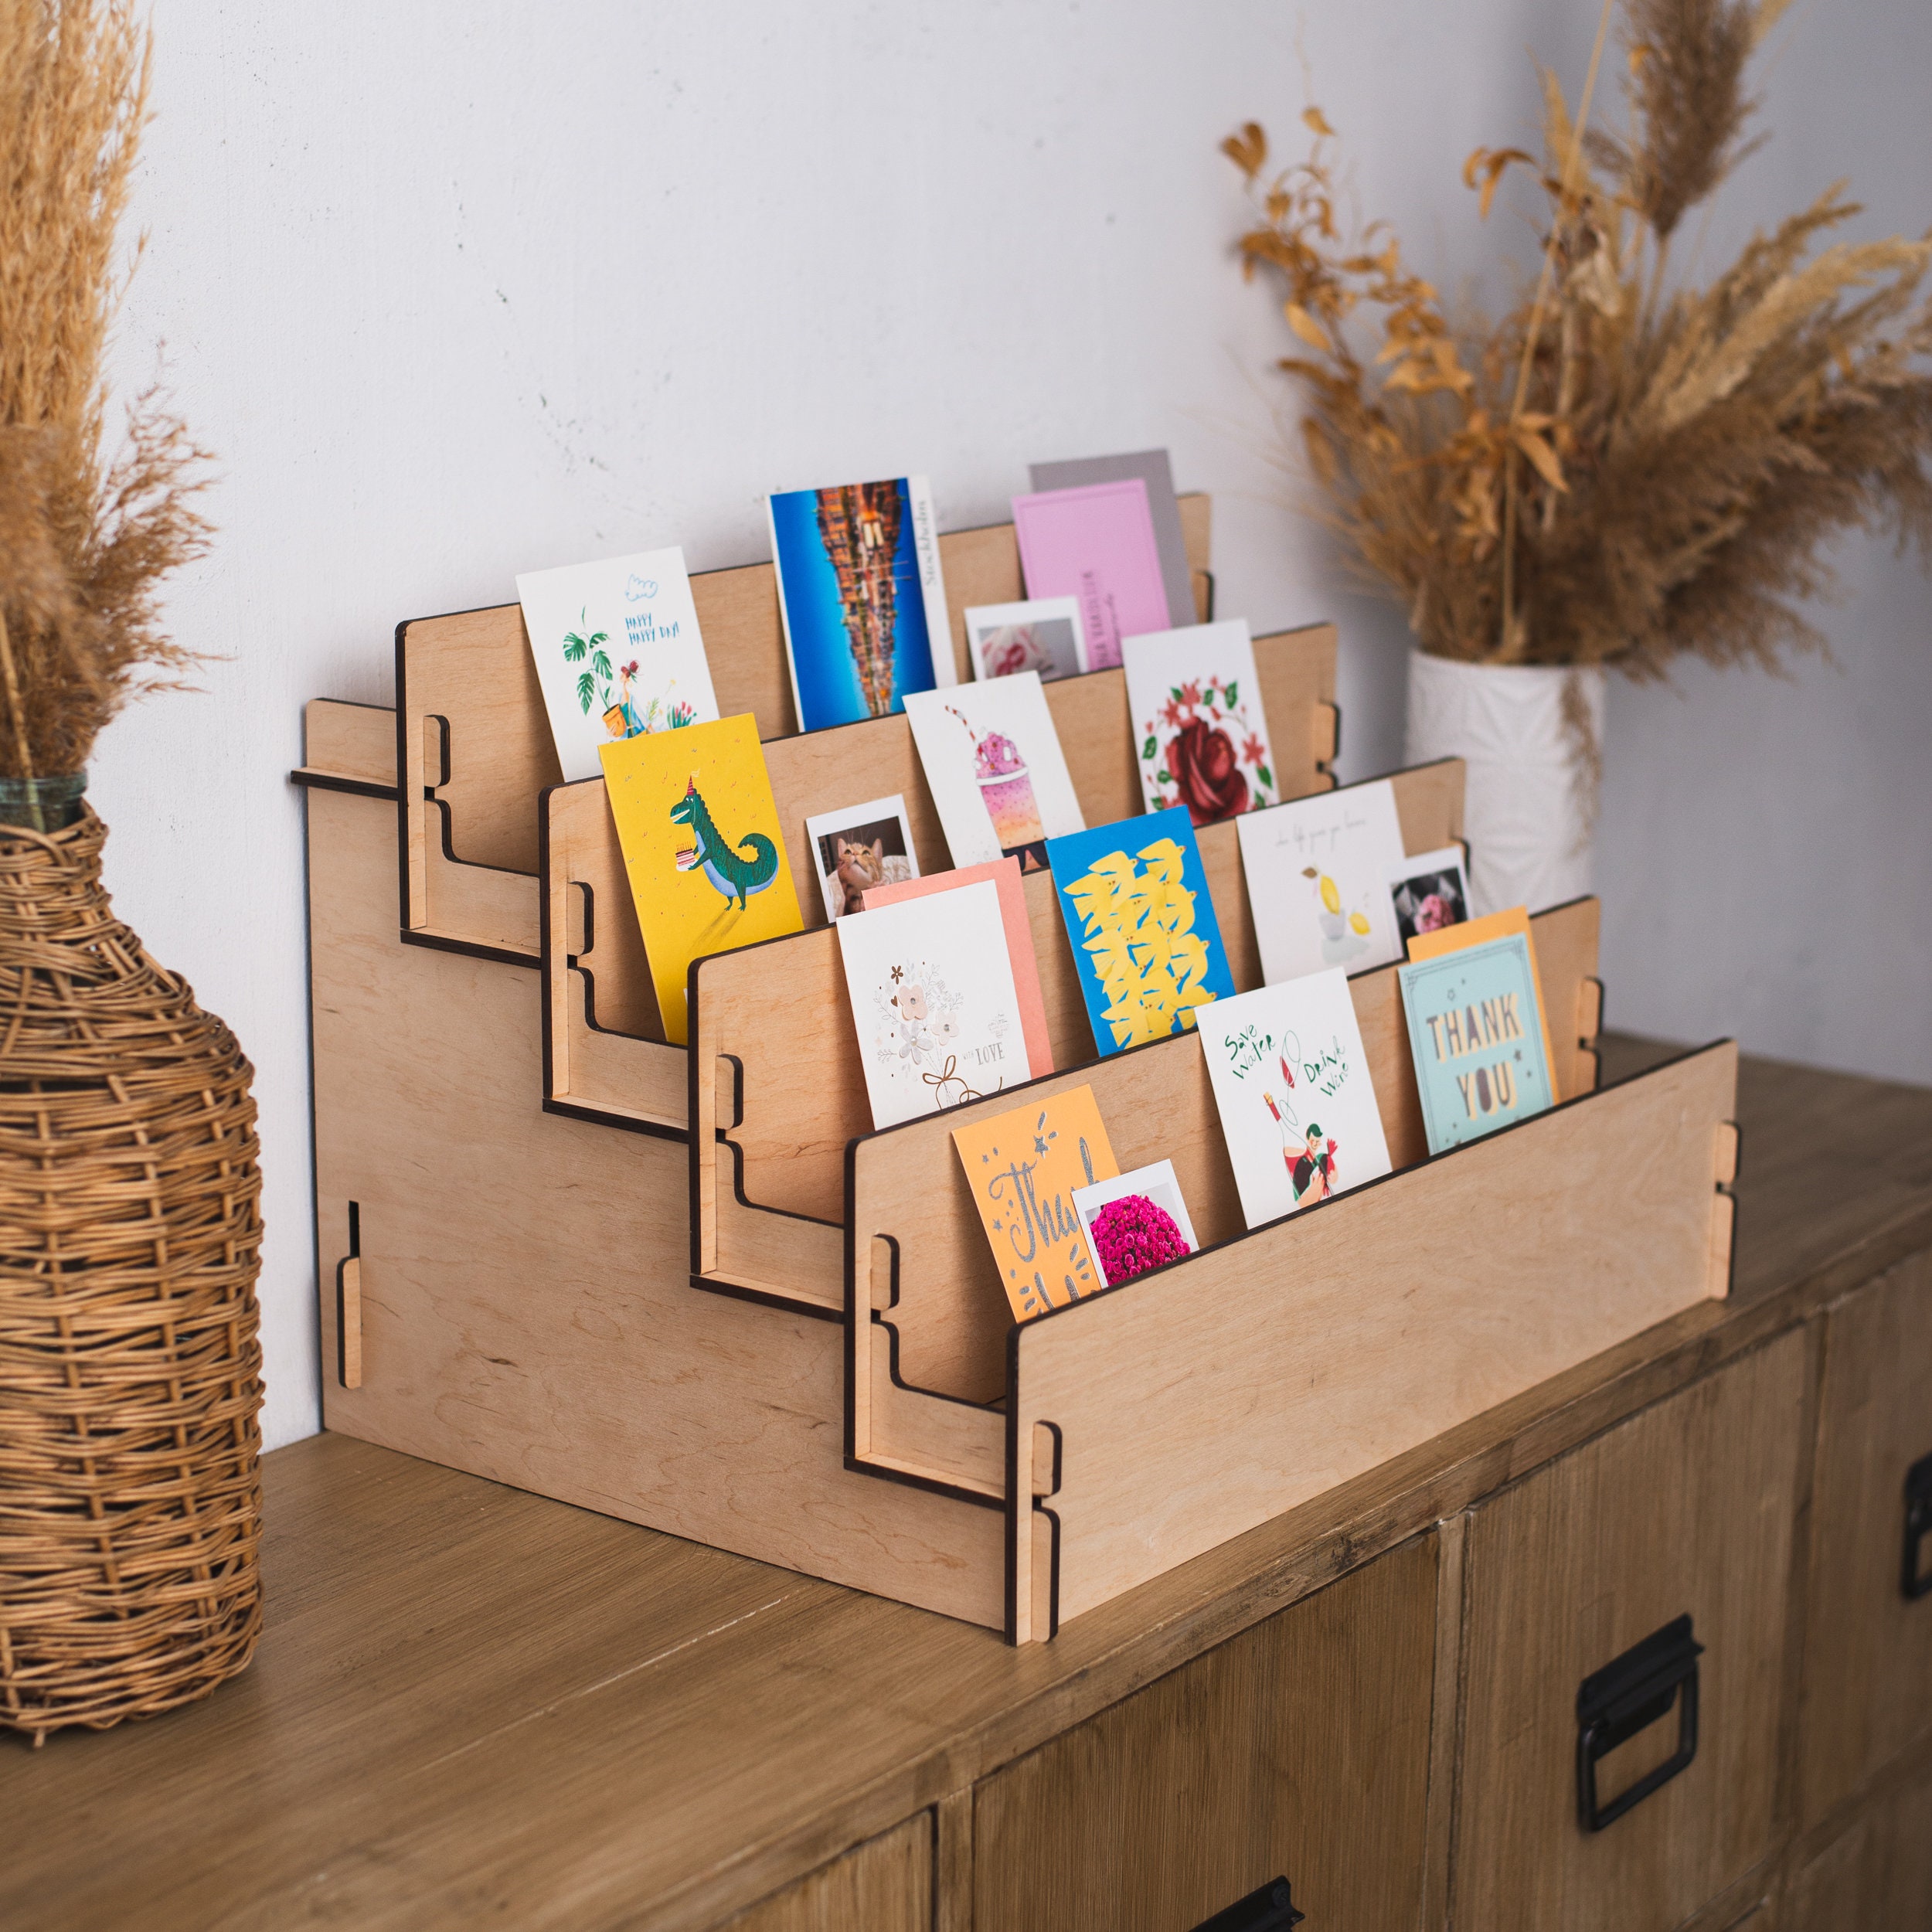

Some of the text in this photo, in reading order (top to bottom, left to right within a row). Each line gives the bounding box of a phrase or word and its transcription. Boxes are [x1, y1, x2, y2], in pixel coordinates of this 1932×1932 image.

[625, 612, 651, 631] HAPPY
[628, 621, 679, 645] HAPPY DAY!
[1225, 1024, 1257, 1061] Save
[1426, 992, 1526, 1063] THANK
[975, 1042, 1005, 1066] LOVE
[1456, 1060, 1517, 1121] YOU
